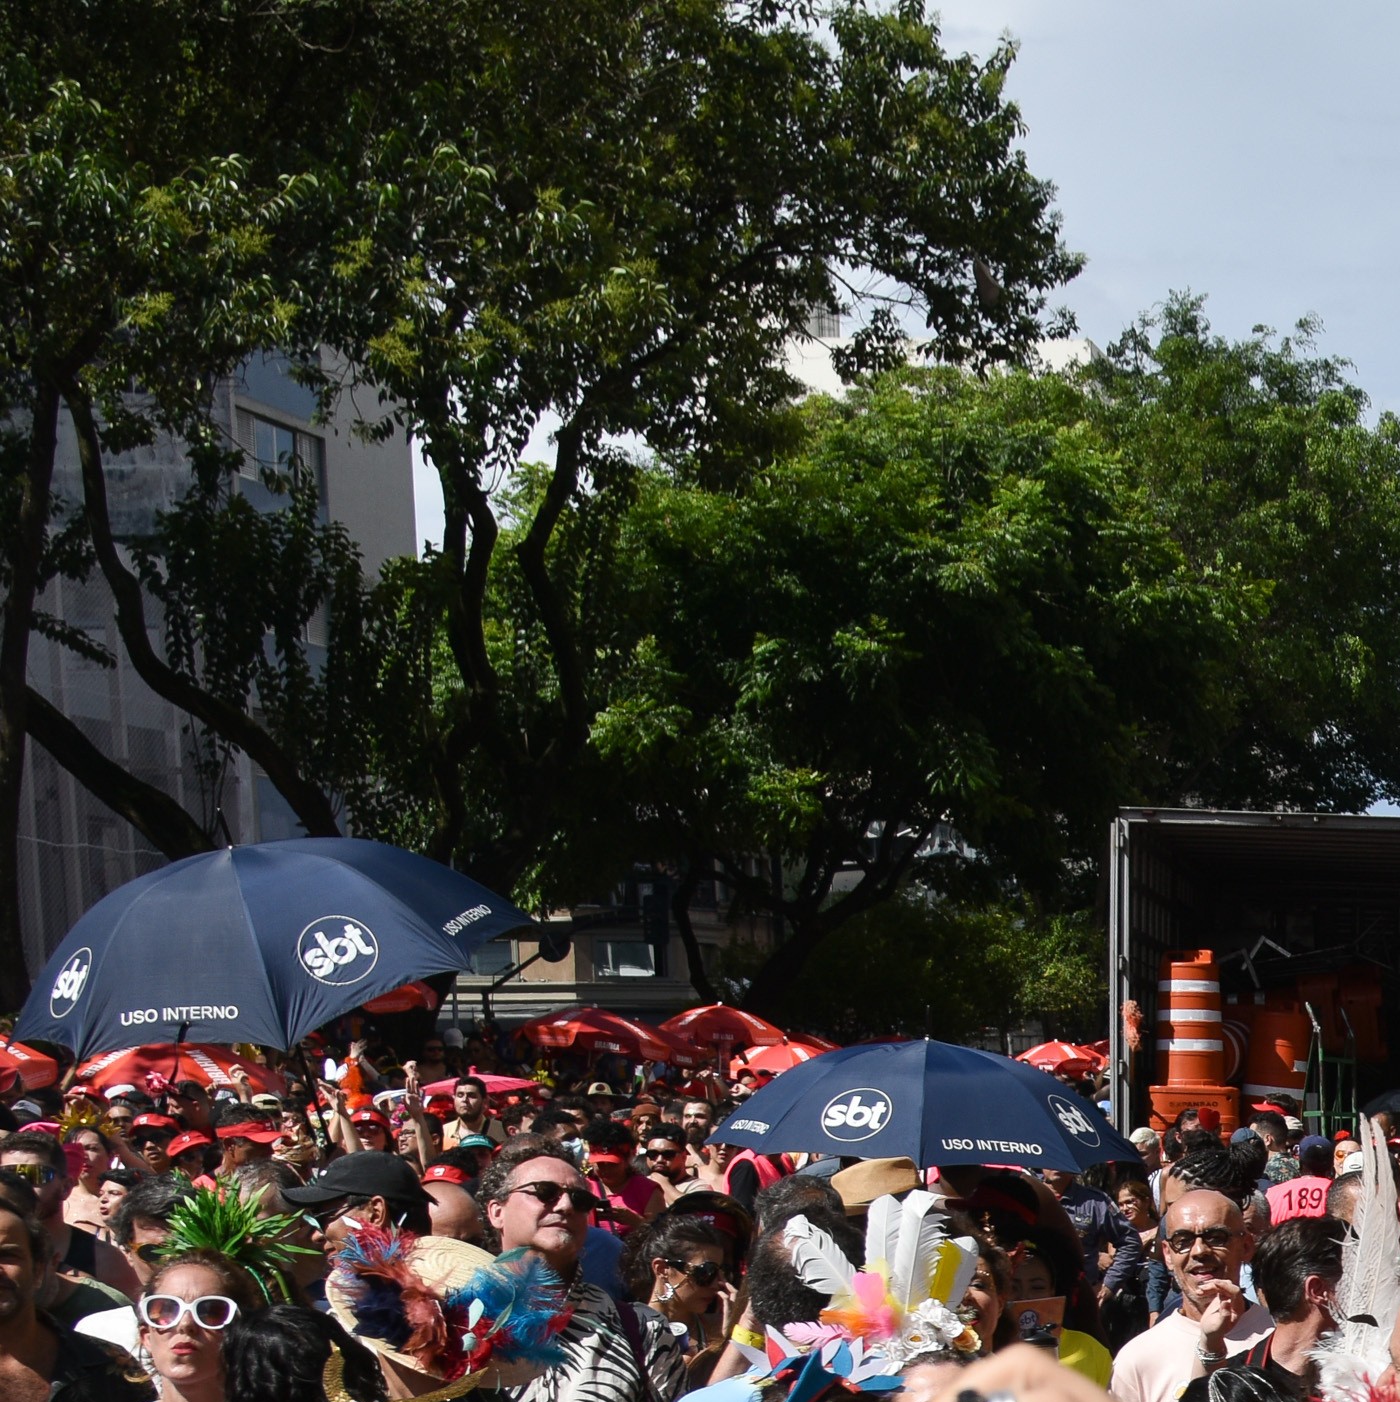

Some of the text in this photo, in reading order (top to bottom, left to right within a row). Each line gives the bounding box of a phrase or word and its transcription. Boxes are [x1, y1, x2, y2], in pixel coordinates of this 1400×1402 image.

[303, 923, 375, 978] sbt
[52, 957, 89, 1002] sbt
[120, 1004, 240, 1026] USO INTERNO
[824, 1096, 888, 1131] sbt
[1057, 1102, 1095, 1136] sbt
[942, 1138, 1043, 1156] USO INTERNO
[1283, 1187, 1324, 1211] 189
